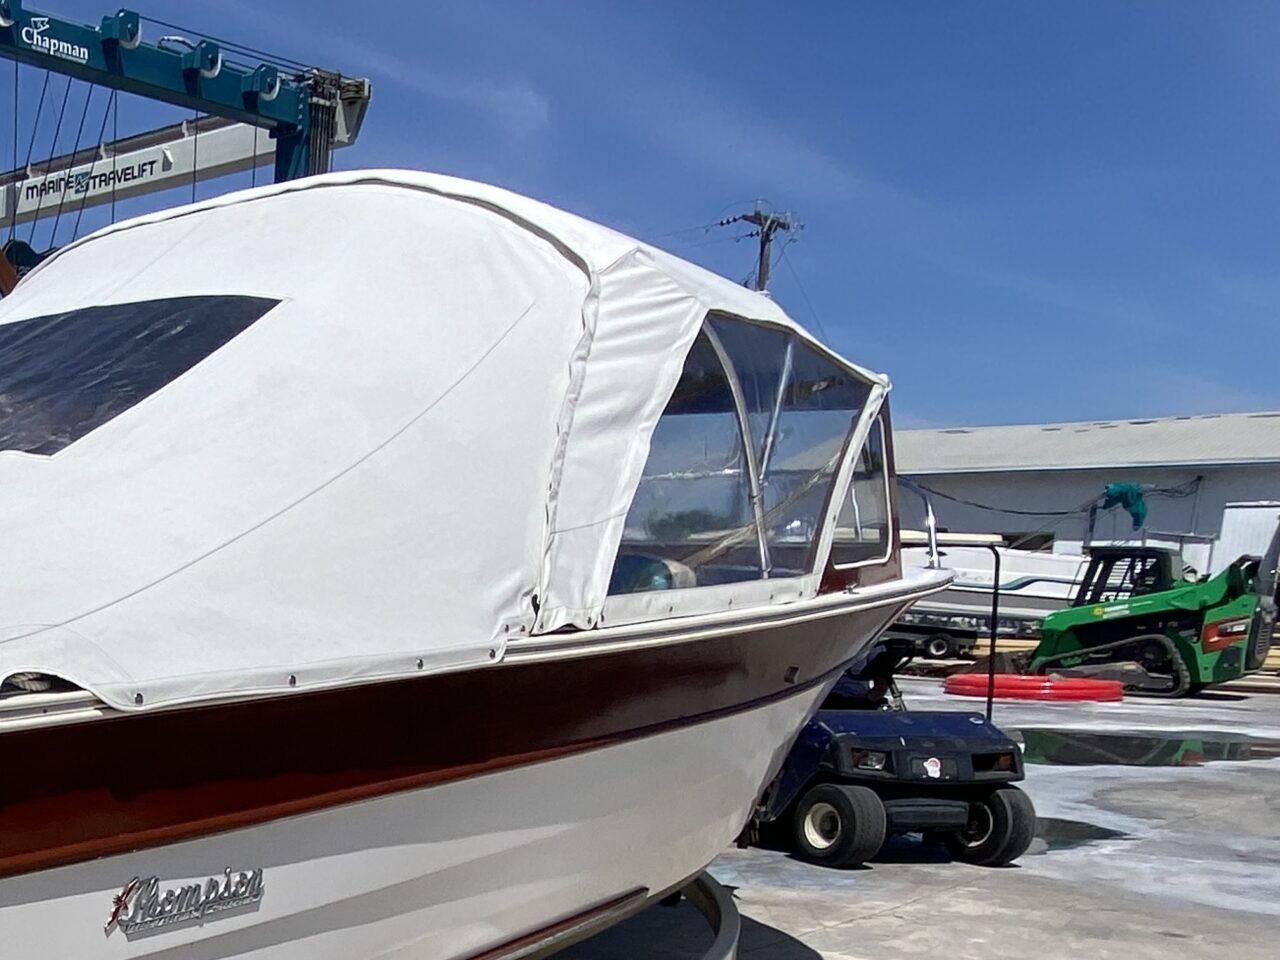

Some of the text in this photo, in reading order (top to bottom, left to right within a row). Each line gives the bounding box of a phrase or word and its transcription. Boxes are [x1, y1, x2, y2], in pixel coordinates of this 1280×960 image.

[21, 26, 89, 60] Chapman
[25, 160, 158, 200] MARINE TRAVELIFT
